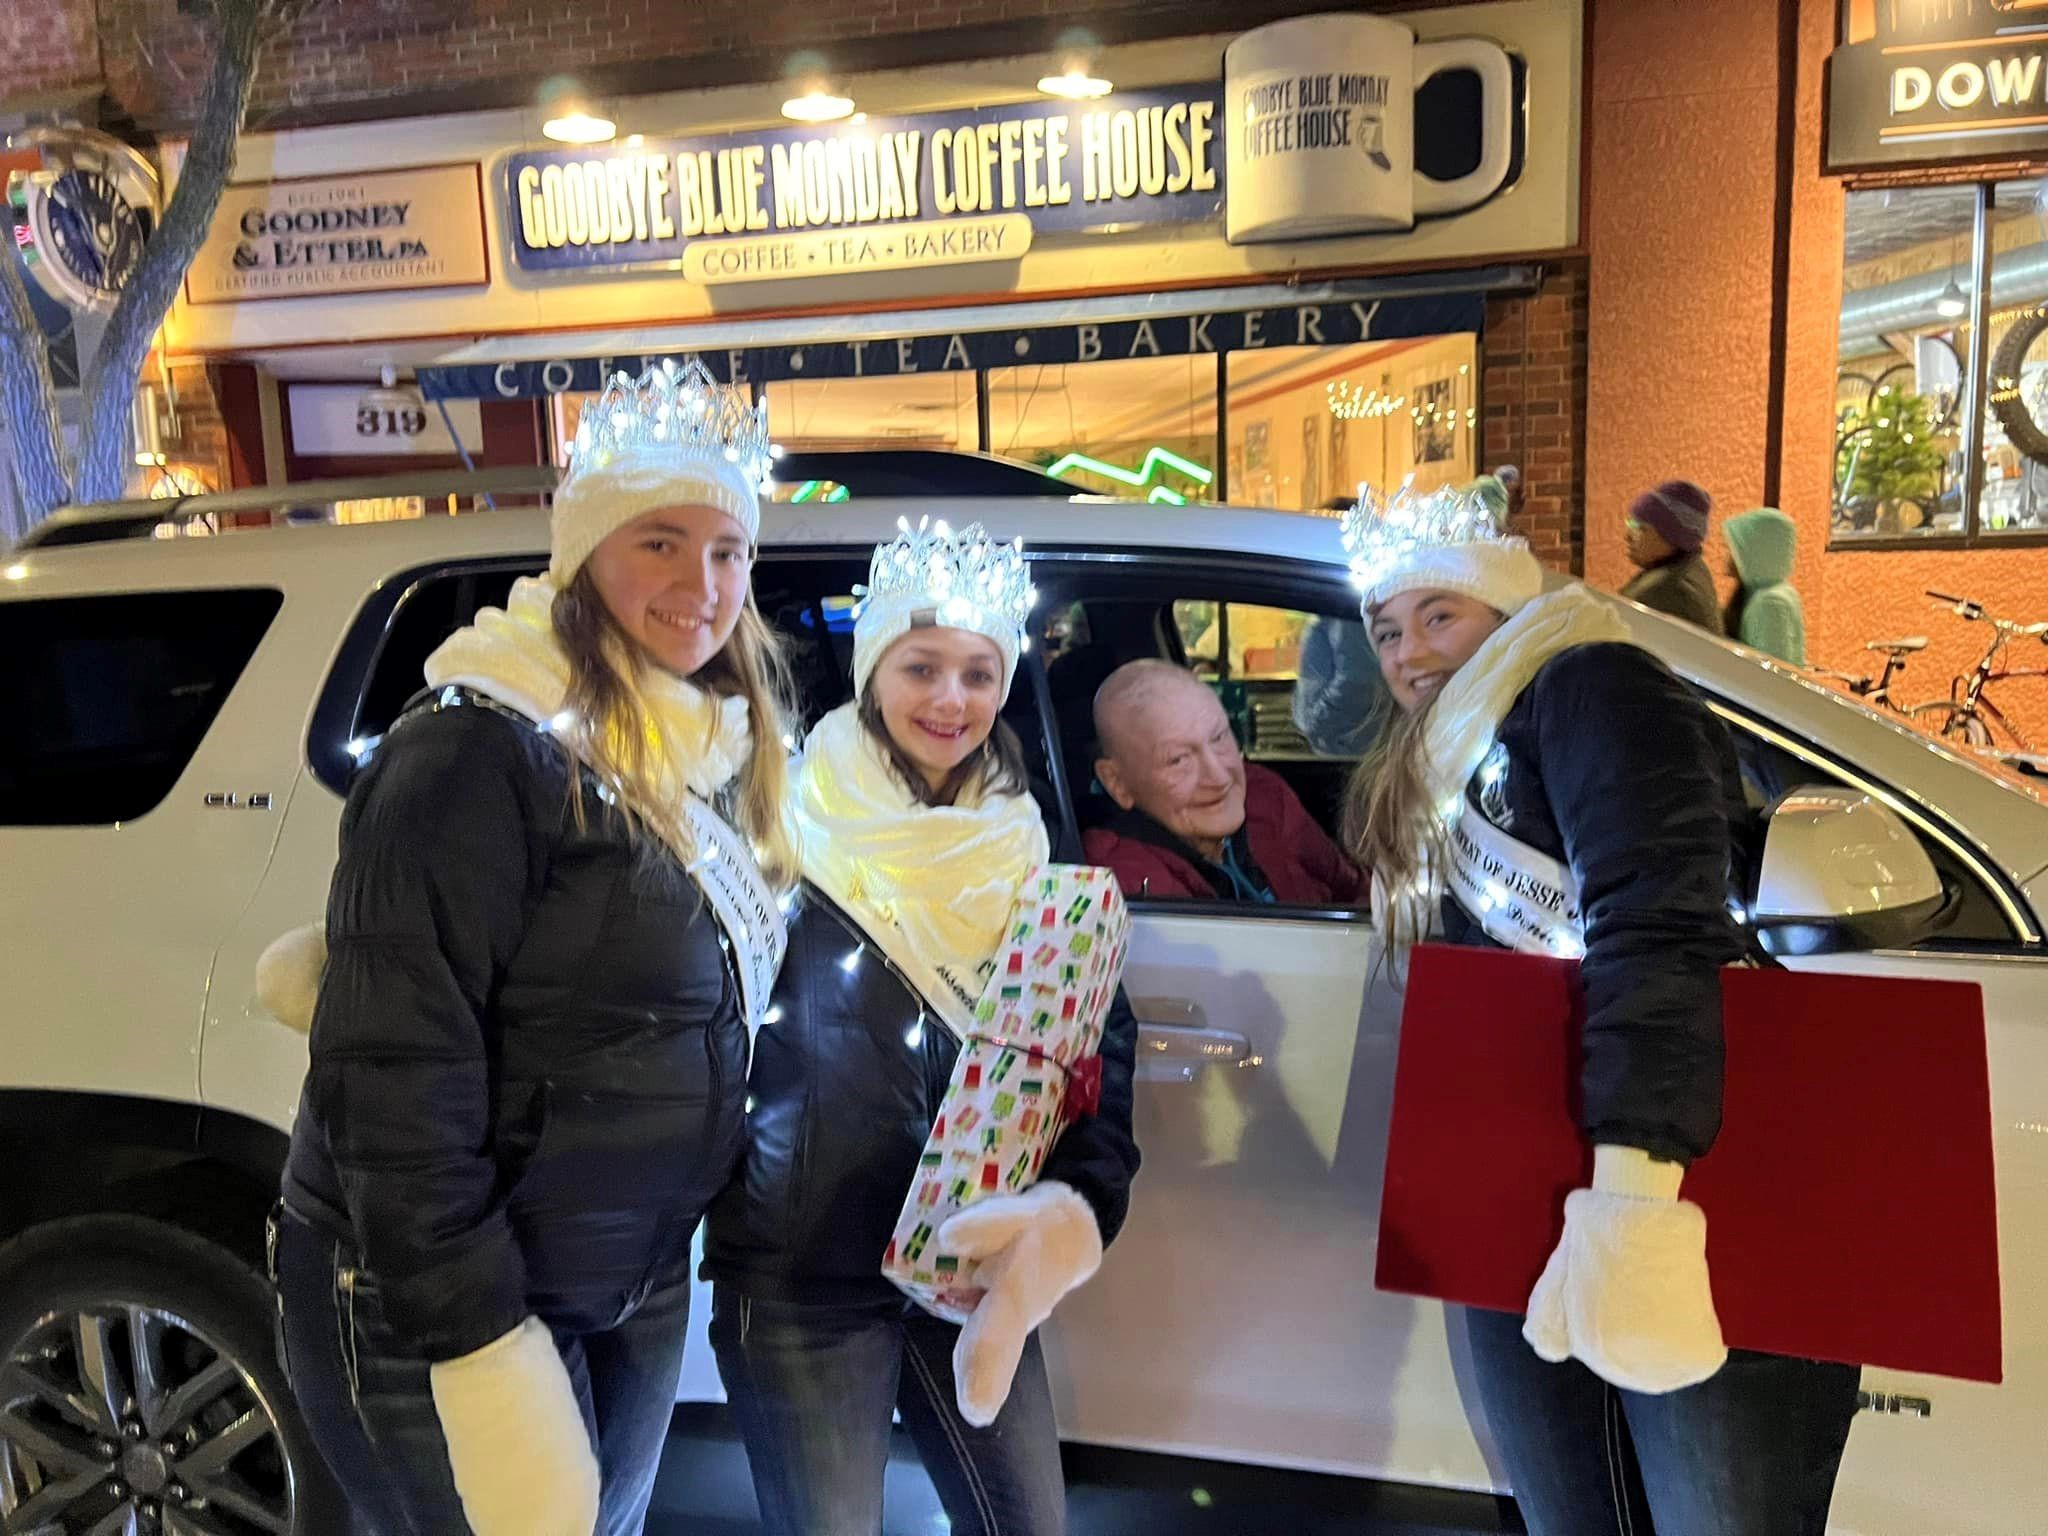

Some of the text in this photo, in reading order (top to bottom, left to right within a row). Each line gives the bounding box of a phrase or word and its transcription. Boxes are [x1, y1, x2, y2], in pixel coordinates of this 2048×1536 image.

[1299, 73, 1334, 108] BLUE
[1338, 73, 1391, 107] MONDAY
[1890, 55, 2048, 116] DOW
[1297, 109, 1352, 150] HOUSE
[517, 100, 1216, 250] GOODBYE BLUE MONDAY COFFEE HOUSE
[240, 201, 411, 238] GOODNEY
[231, 242, 260, 270] &
[702, 225, 1008, 275] COFFEE TEA BAKERY
[846, 333, 972, 377] TEA
[1077, 301, 1382, 360] BAKERY
[356, 407, 428, 438] 319
[1483, 854, 1504, 878] OF
[1505, 870, 1566, 914] JESSE
